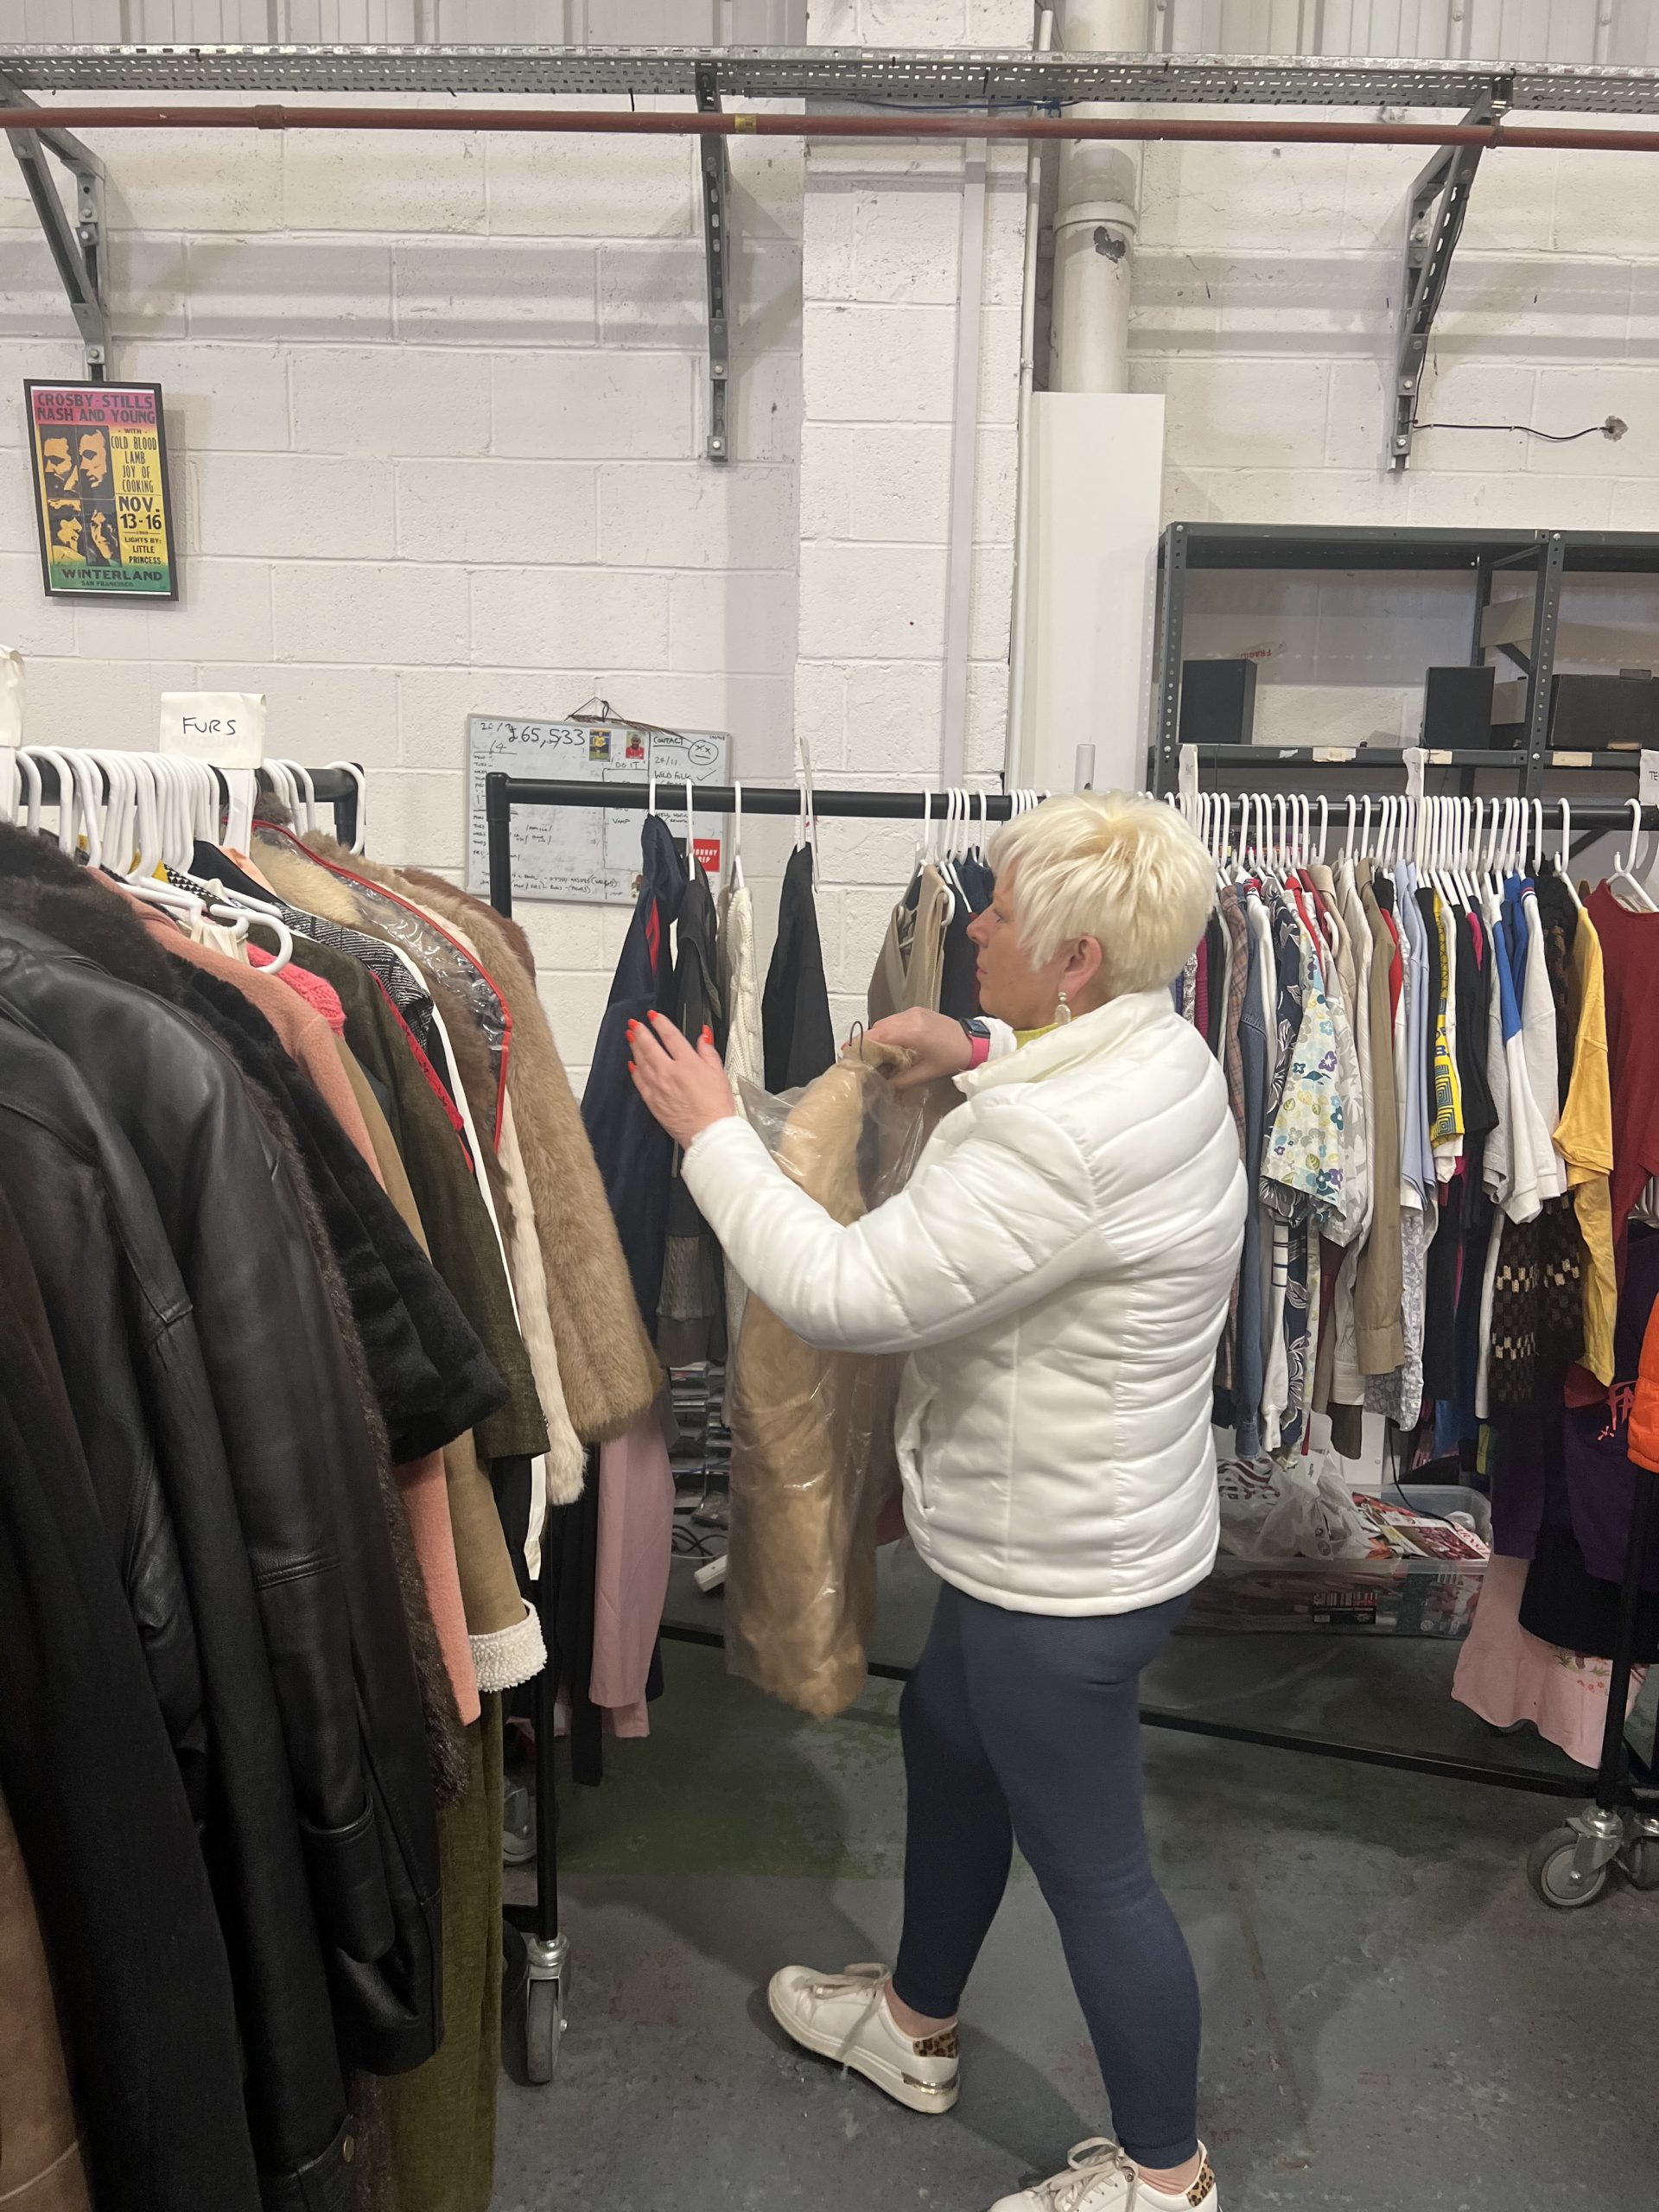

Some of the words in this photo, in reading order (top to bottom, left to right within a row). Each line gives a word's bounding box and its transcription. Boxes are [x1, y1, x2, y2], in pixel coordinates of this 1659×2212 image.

[38, 407, 74, 422] NASH
[79, 409, 105, 422] AND
[111, 410, 156, 424] YOUNG
[111, 435, 129, 449] COLD
[133, 435, 157, 450] BLOOD
[124, 450, 145, 465] LAMB
[123, 464, 136, 479] JOY
[141, 466, 151, 479] OF
[122, 479, 154, 493] COOKING
[118, 496, 160, 513] NOV.
[132, 545, 155, 554] LITTLE
[129, 556, 162, 565] PRINCESS
[61, 569, 163, 582] WINTERLAND
[182, 716, 237, 736] FURS
[1649, 770, 1659, 782] TE
